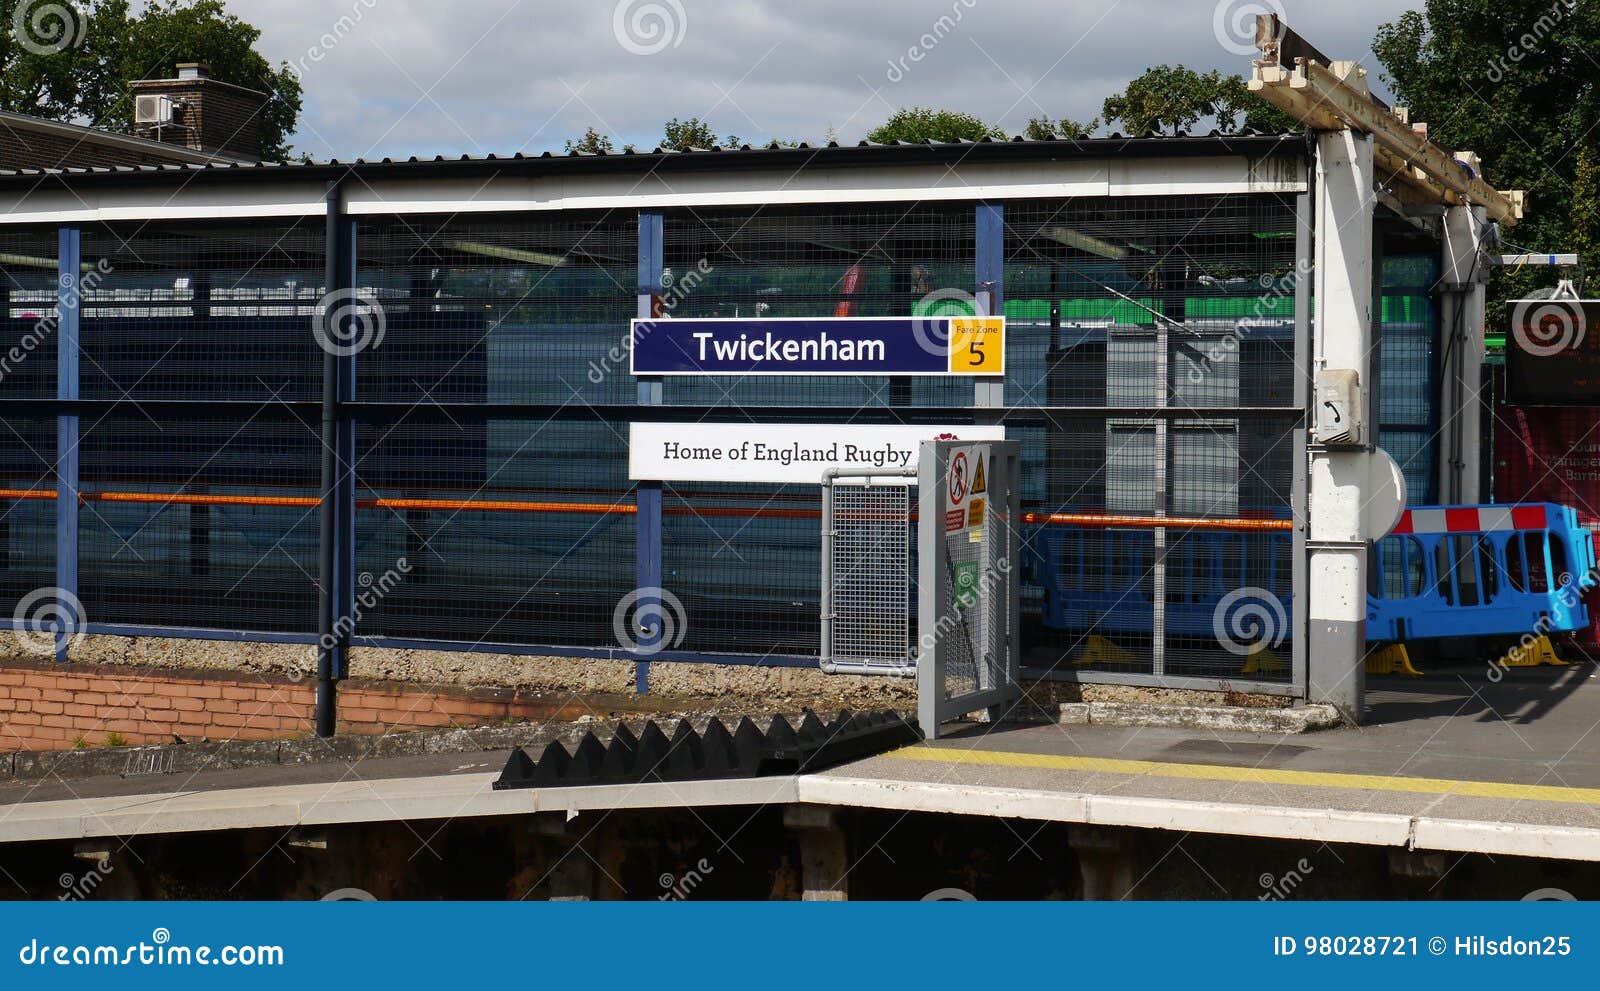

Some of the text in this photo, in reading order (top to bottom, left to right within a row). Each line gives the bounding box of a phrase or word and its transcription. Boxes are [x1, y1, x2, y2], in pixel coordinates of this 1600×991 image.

[956, 325, 998, 334] Fare Zone
[692, 331, 885, 361] Twickenham
[969, 341, 985, 366] 5
[663, 442, 913, 467] Home of England Rugby
